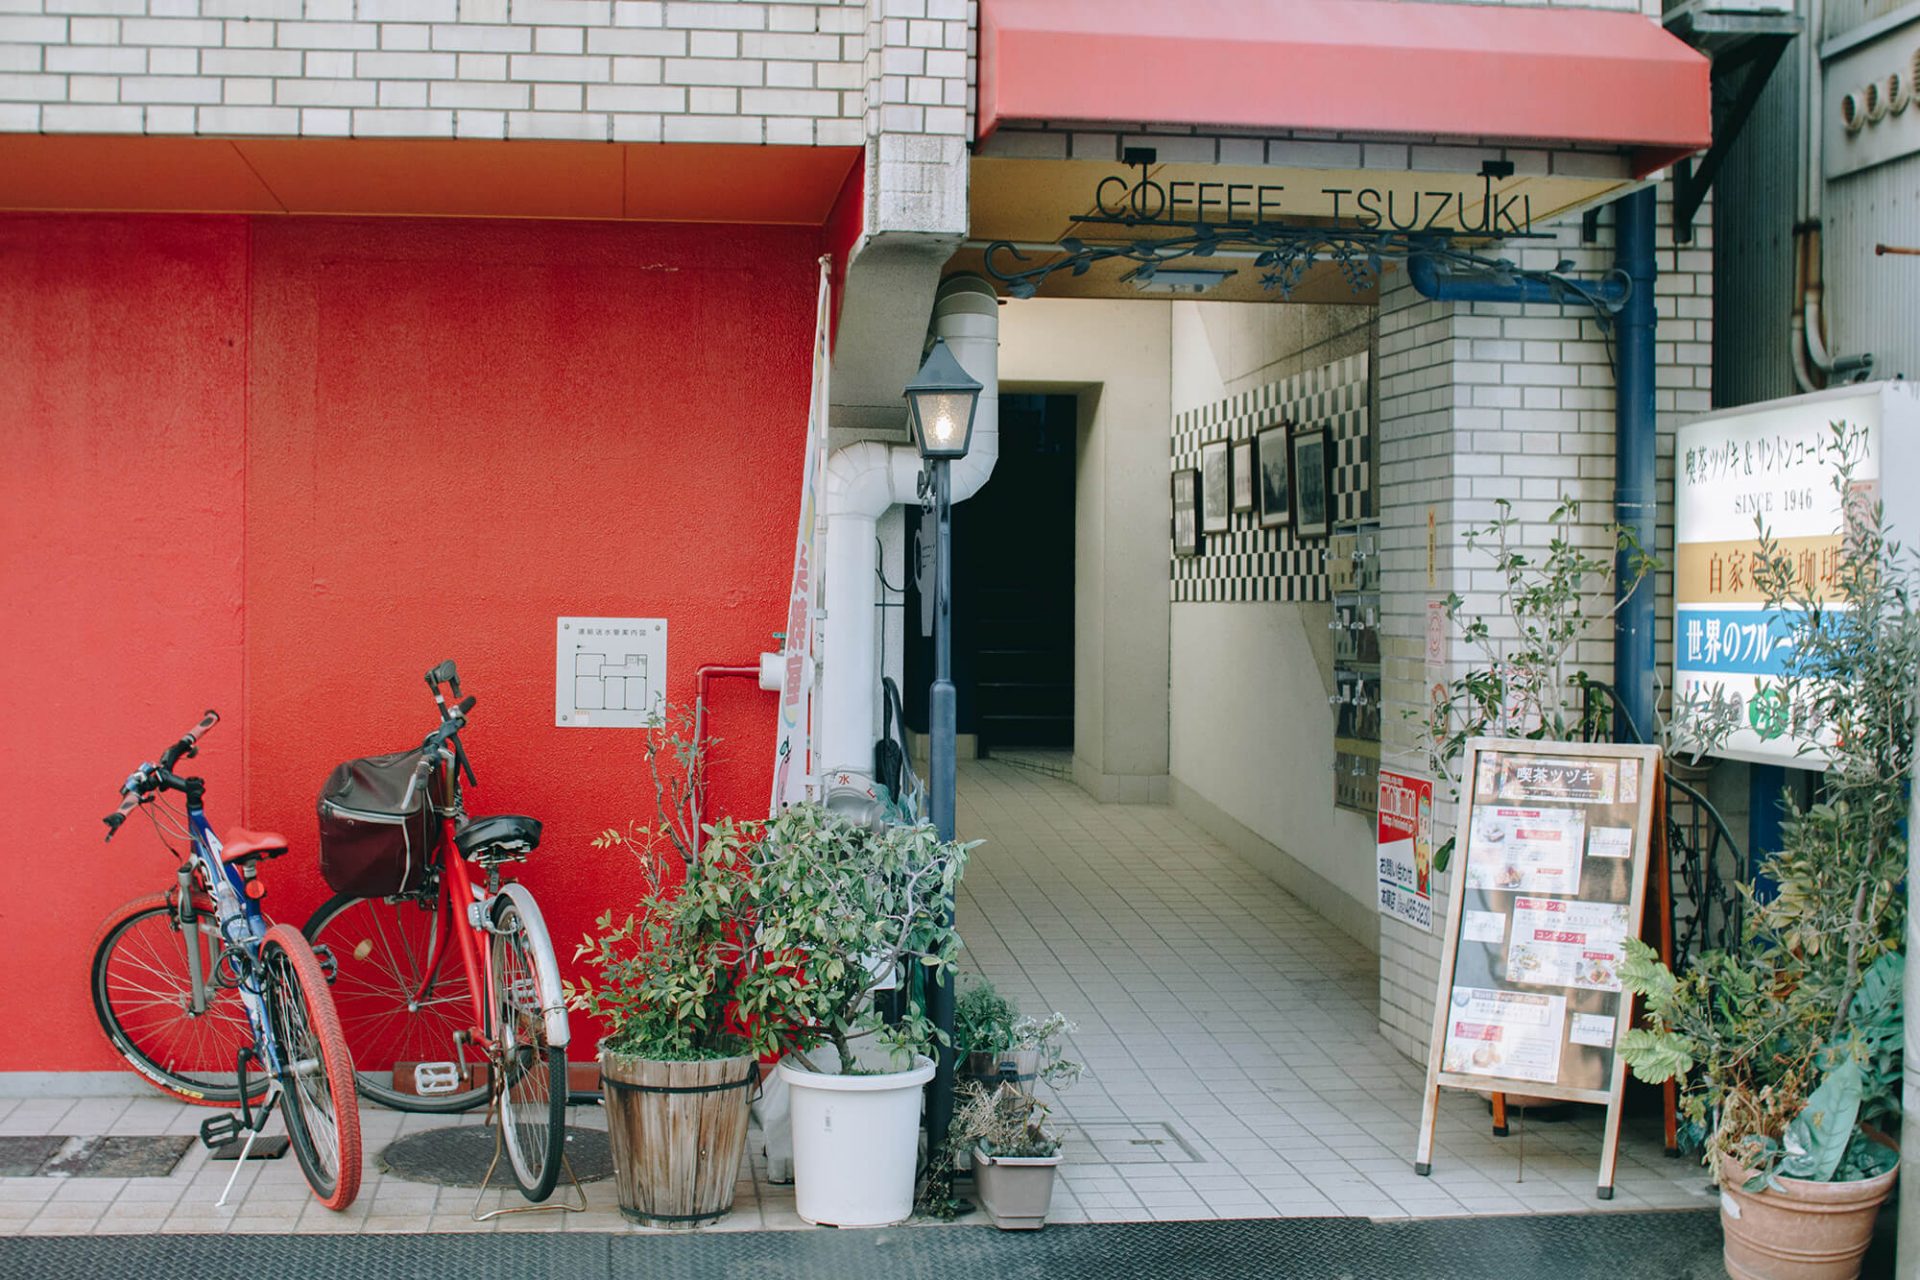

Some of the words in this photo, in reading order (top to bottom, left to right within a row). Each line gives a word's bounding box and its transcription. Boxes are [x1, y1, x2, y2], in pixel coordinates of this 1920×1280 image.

[1096, 176, 1285, 226] COFFEE
[1321, 188, 1531, 236] TSUZUKI
[1685, 439, 1739, 486] 喫茶ツヅキ
[1758, 427, 1870, 475] リントンコーヒーウス
[1735, 493, 1773, 514] SINCE
[1784, 488, 1812, 511] 1946
[1516, 767, 1595, 785] 喫茶ツヅキ
